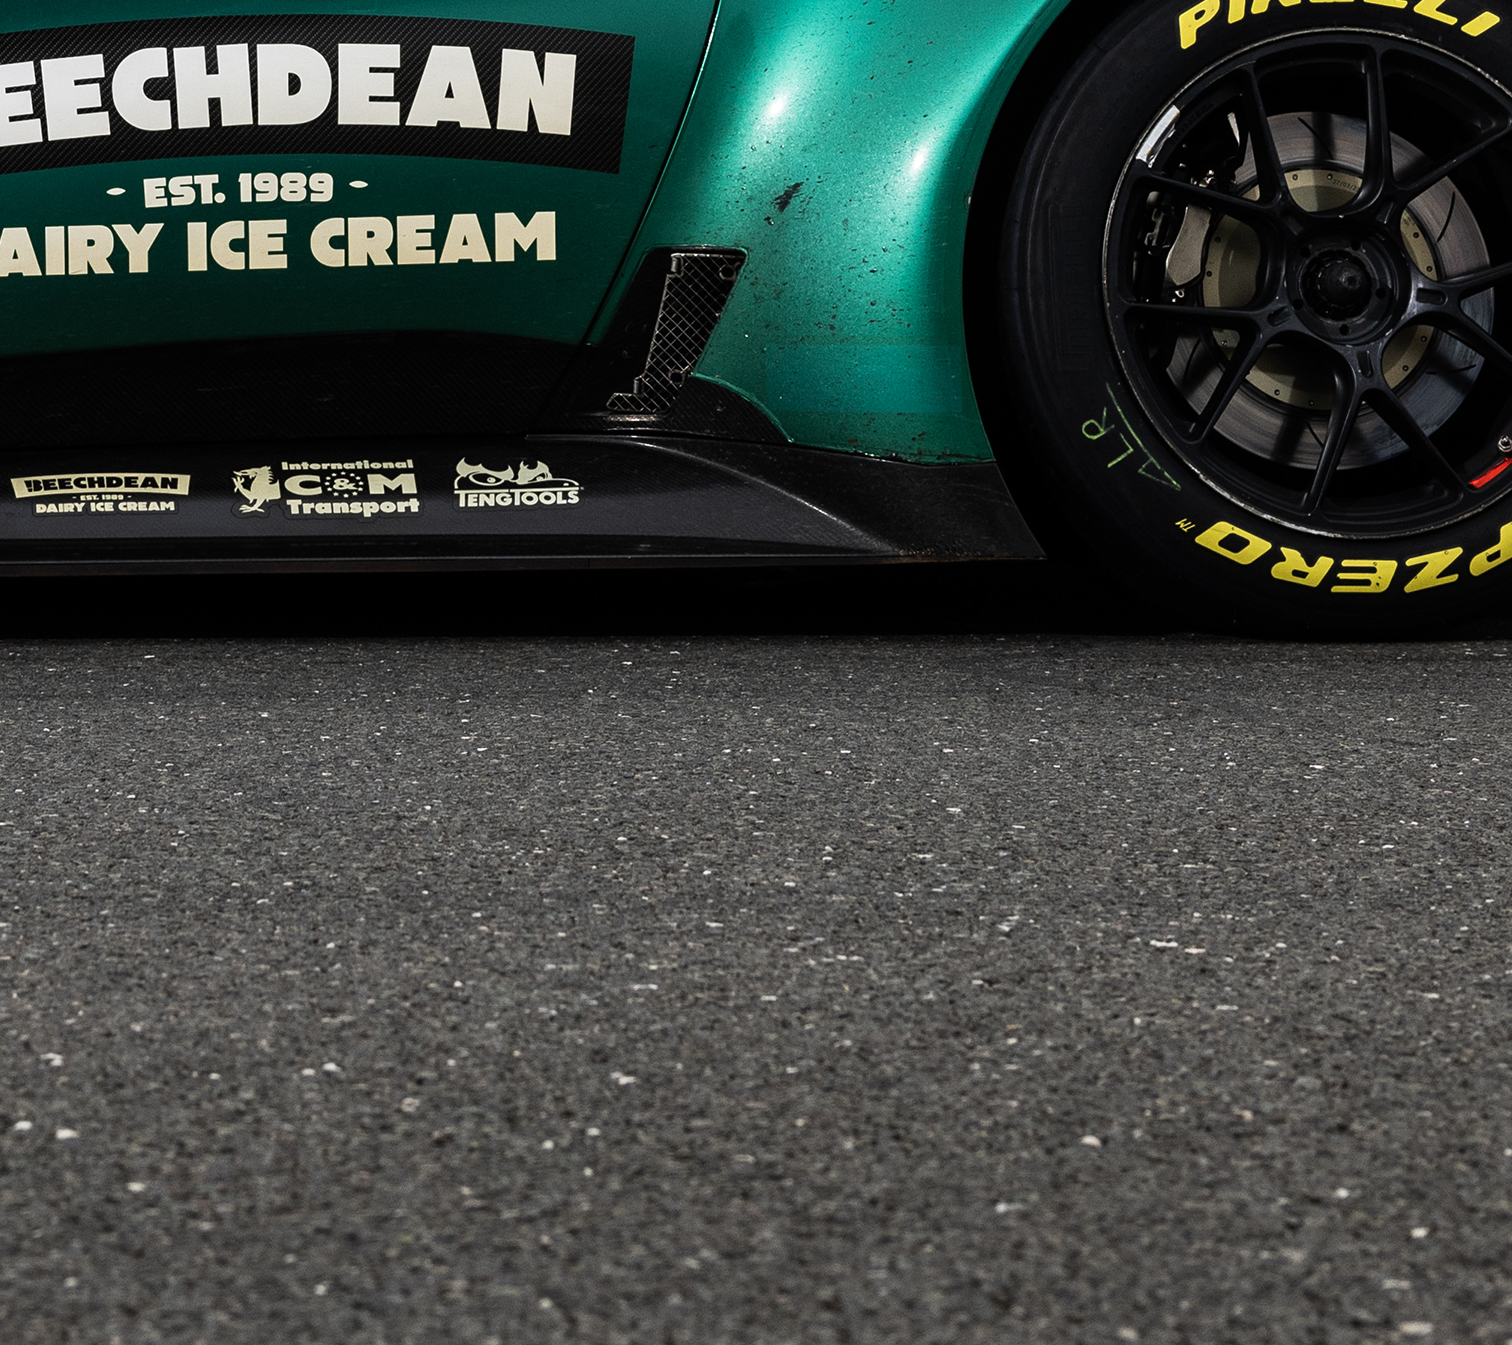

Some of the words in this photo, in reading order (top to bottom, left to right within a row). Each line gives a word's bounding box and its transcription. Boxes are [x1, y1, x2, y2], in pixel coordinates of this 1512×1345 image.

[142, 173, 226, 209] EST.
[237, 172, 334, 203] 1989
[187, 219, 288, 272] ICE
[310, 210, 557, 268] CREAM
[281, 459, 414, 471] International
[35, 502, 84, 514] DAIRY
[90, 501, 113, 513] ICE
[117, 500, 175, 512] CREAM
[285, 498, 420, 518] Transport
